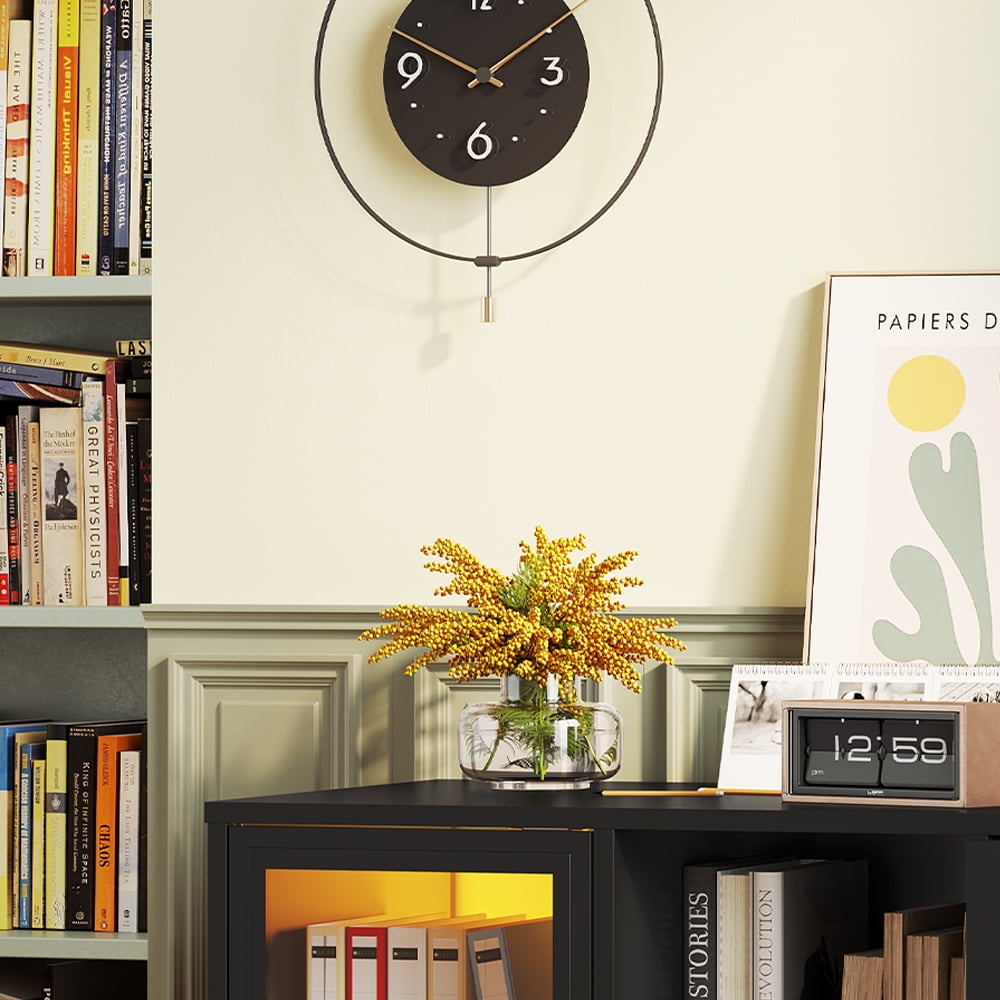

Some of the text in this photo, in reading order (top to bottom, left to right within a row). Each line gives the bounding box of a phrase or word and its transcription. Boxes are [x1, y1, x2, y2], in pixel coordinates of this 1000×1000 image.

[397, 52, 423, 90] 9
[540, 56, 564, 86] 3
[467, 121, 493, 160] 6
[877, 313, 970, 330] PAPIERS
[118, 340, 152, 356] LAS
[0, 365, 17, 375] ide
[87, 426, 101, 579] GREAT PHYSICISTS
[834, 735, 948, 764] 12:59
[82, 762, 90, 787] KING
[811, 769, 824, 777] pm
[82, 791, 89, 805] OF
[98, 824, 111, 868] CHAOS
[81, 853, 89, 885] SPACE
[688, 891, 710, 998] STORIES
